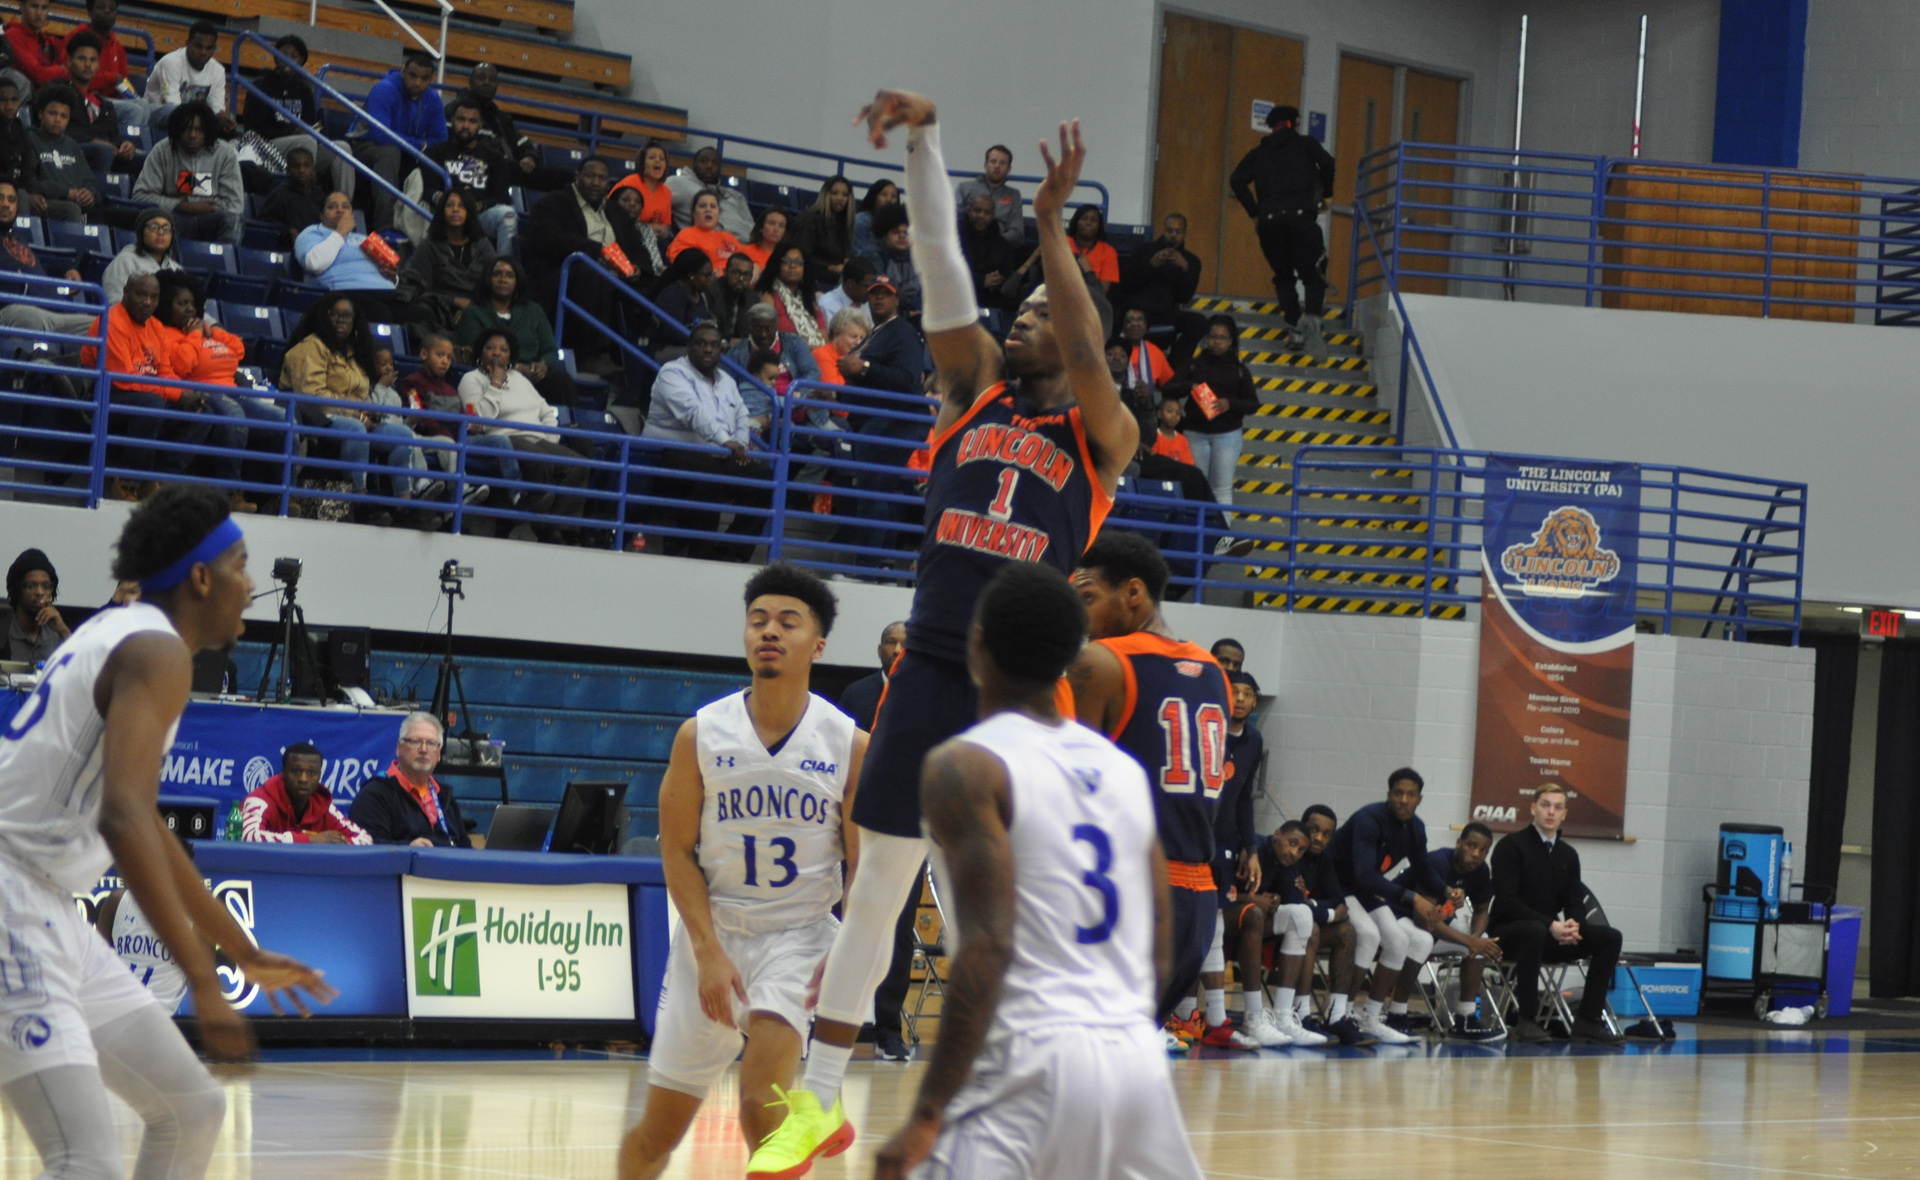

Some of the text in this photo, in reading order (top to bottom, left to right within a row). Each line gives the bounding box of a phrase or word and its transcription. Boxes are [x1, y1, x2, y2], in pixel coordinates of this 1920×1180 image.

[956, 423, 1074, 492] LINCOLN
[1519, 466, 1611, 482] THE LINCOLN
[988, 467, 1019, 522] 1
[1506, 478, 1623, 498] UNIVERSITY (PA)
[936, 508, 1049, 563] UNIVERSITY
[1513, 556, 1609, 577] LINCOLN
[1527, 579, 1583, 594] LIONS
[1869, 610, 1901, 638] EXIT
[1534, 662, 1577, 673] Established
[1526, 703, 1580, 715] Re-Joined 2010
[1528, 693, 1580, 704] Member Since
[1523, 735, 1580, 746] Orange and Blue
[1540, 725, 1565, 735] Colors
[1158, 698, 1228, 799] 10
[160, 754, 235, 787] MAKE
[800, 759, 837, 775] CIAA
[1529, 756, 1571, 766] Team Name
[1540, 767, 1559, 776] Lions
[717, 784, 829, 825] BRONCOS
[1473, 805, 1517, 823] CIAA
[742, 833, 799, 888] 13
[1767, 838, 1778, 897] POWERADE
[1071, 822, 1120, 945] 3
[483, 906, 623, 955] Holiday Inn
[117, 934, 176, 966] BRONCO
[538, 957, 581, 992] I-95
[1640, 983, 1690, 995] POWERADE
